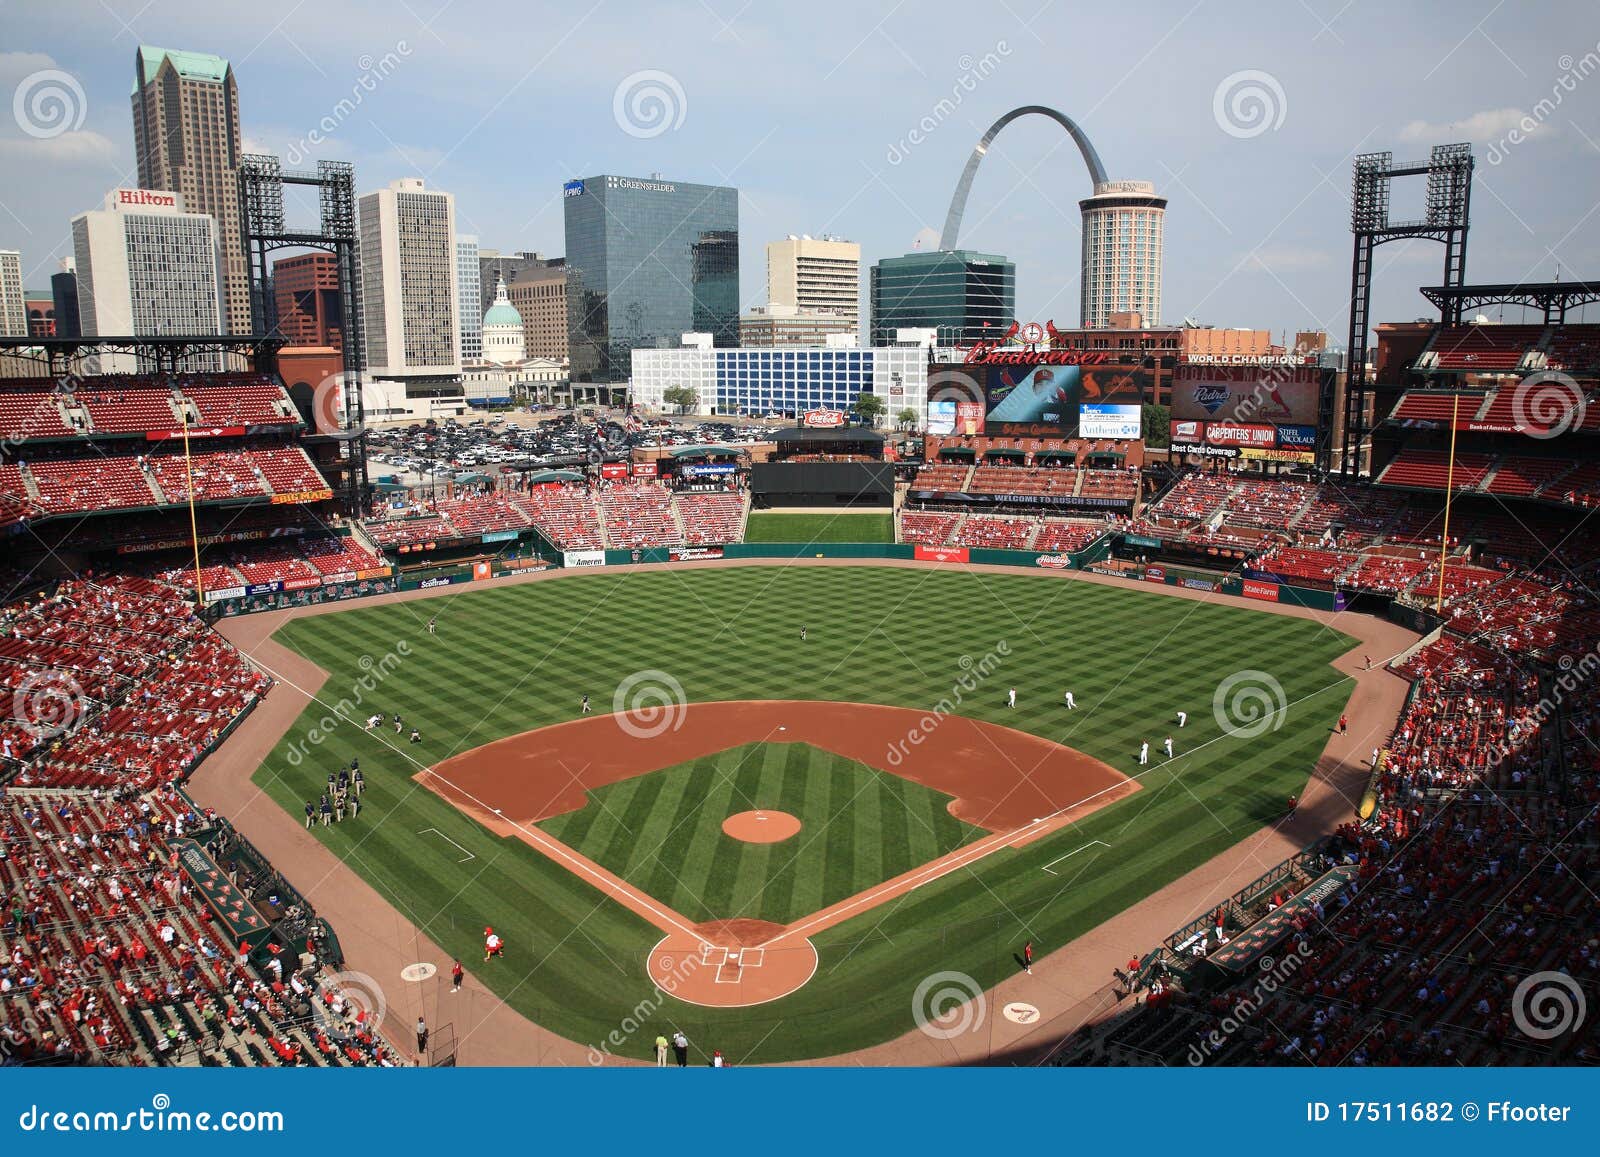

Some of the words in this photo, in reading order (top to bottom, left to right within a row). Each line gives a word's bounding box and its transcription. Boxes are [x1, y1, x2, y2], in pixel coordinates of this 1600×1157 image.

[564, 186, 582, 198] KPMG
[620, 178, 676, 193] GREENSFELDER
[119, 190, 175, 206] Hilton
[955, 340, 1109, 365] Budweiser
[1188, 354, 1228, 364] WORLD
[1232, 354, 1305, 365] CHAMPIONS
[1193, 387, 1231, 401] Padres
[1207, 427, 1252, 440] CARPENTERS'
[1252, 429, 1274, 441] UNION
[1279, 428, 1298, 436] STIFEL
[1281, 434, 1315, 443] NICOLAUS
[1171, 444, 1187, 453] Best
[1206, 447, 1236, 458] Coverage
[280, 493, 299, 503] BIG
[301, 490, 325, 501] MAC
[994, 495, 1038, 503] WELCOME
[1052, 496, 1084, 505] BUSCH
[1086, 498, 1128, 507] STADIUM
[196, 534, 226, 545] PARTY
[230, 531, 262, 541] PORCH
[576, 558, 602, 566] Ameren
[421, 577, 450, 588] Scottrade
